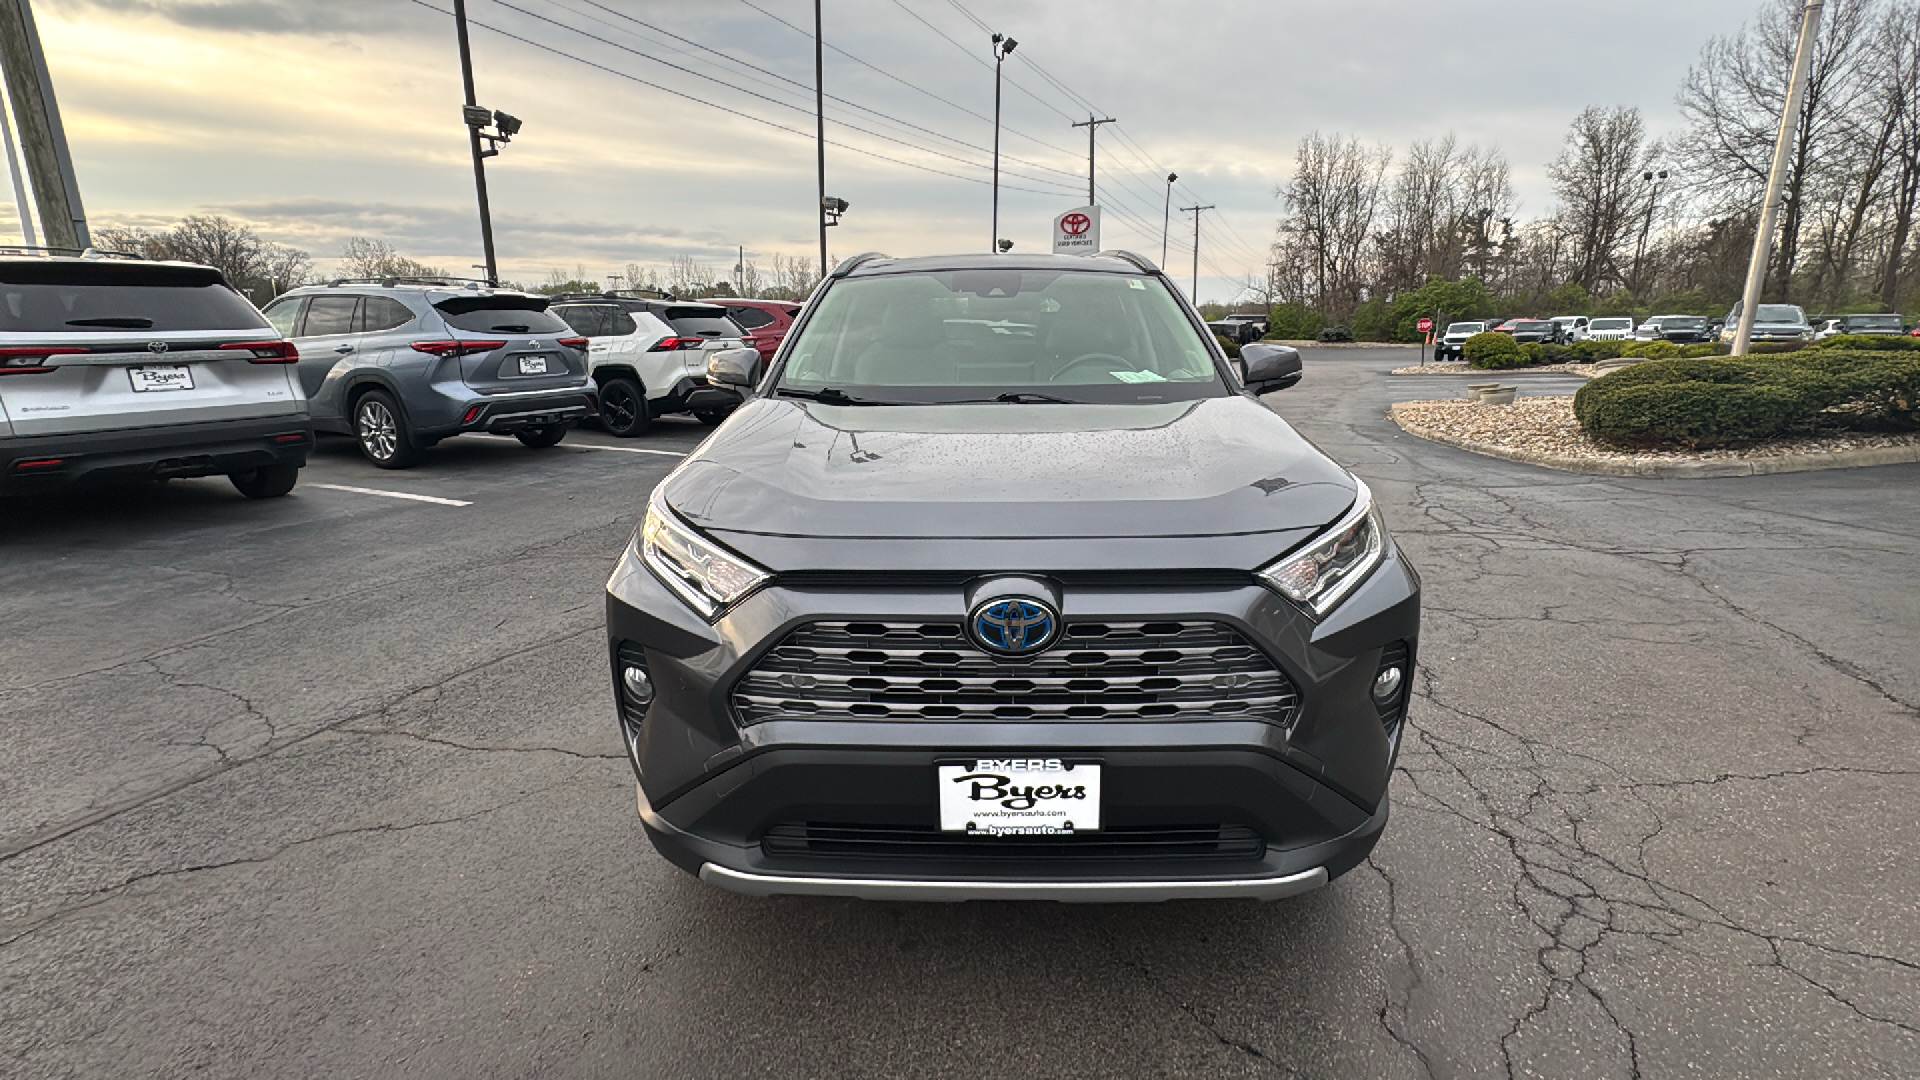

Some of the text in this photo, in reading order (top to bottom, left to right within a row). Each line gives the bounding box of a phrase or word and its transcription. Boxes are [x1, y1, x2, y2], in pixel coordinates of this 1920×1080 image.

[136, 371, 186, 384] Byers
[976, 758, 1062, 772] BYERS
[952, 774, 1086, 810] Byers
[973, 810, 1067, 818] www.byersauto.com
[967, 825, 1074, 837] www.byersauto.com
